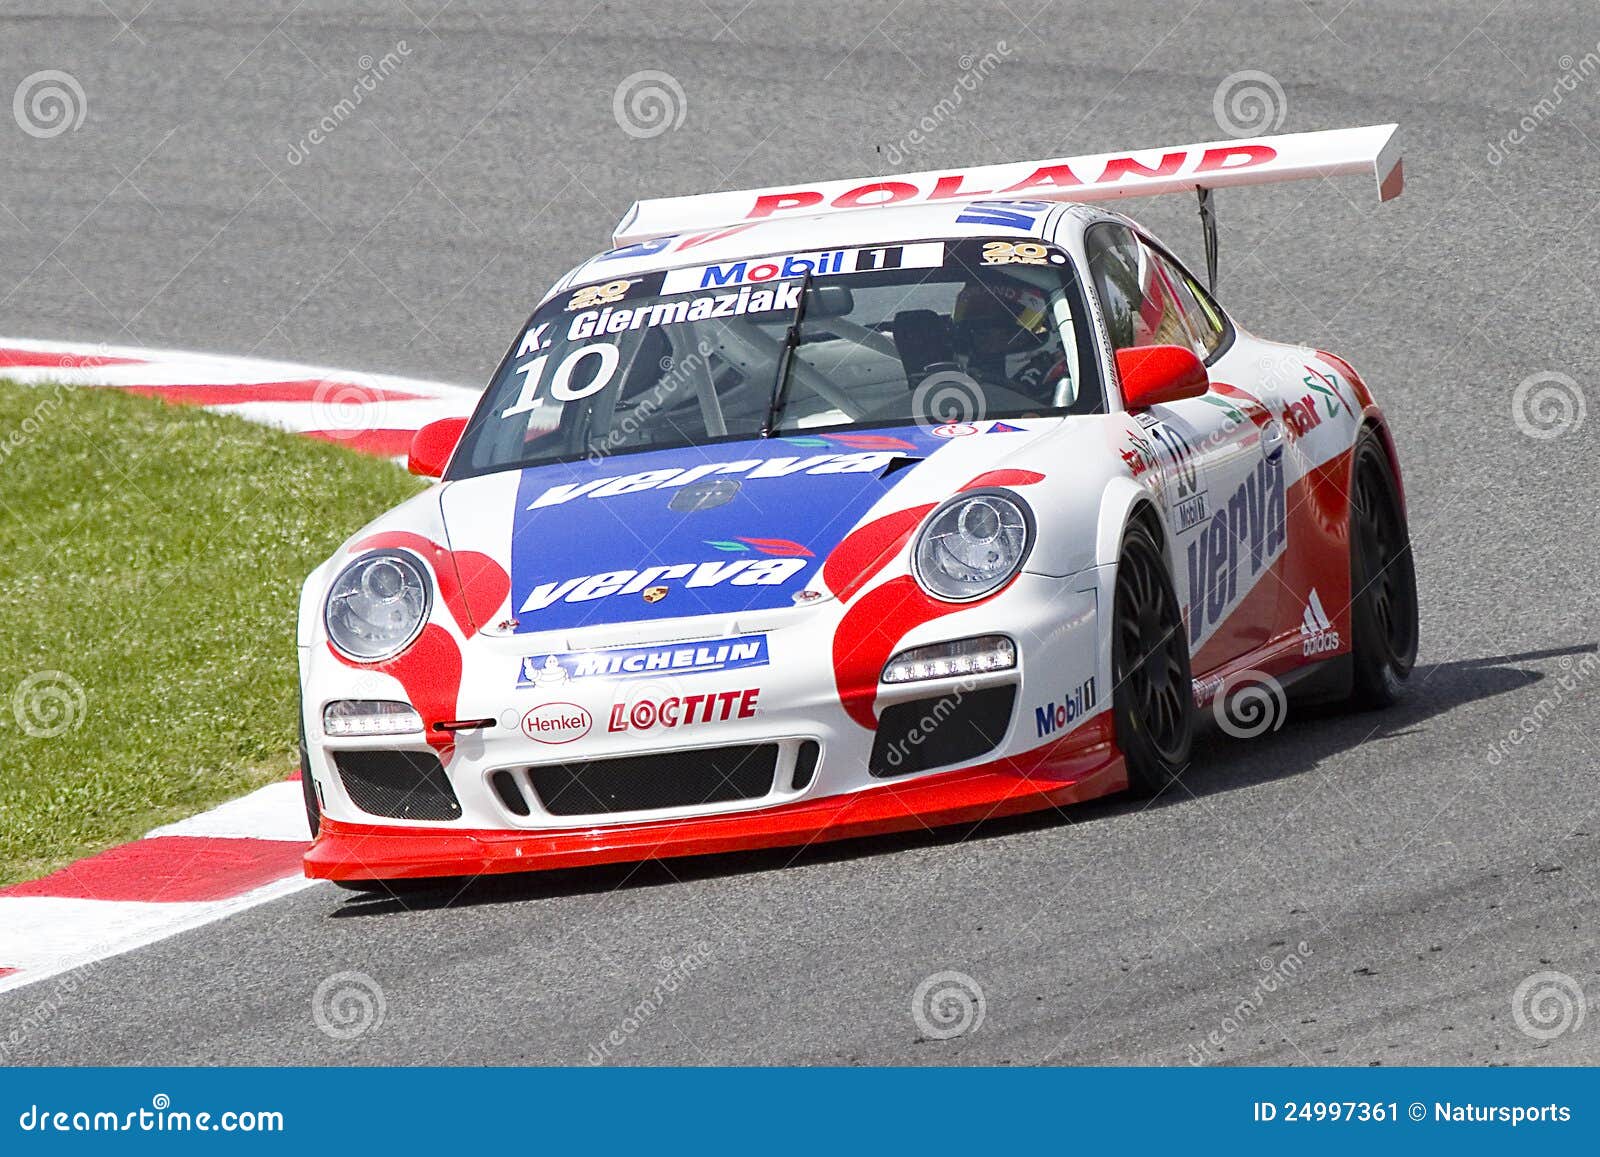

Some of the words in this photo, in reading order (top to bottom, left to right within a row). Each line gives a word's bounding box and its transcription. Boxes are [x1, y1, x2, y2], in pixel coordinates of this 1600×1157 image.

[745, 145, 1278, 219] POLAND
[700, 251, 844, 288] Mobil
[982, 241, 1048, 259] 20
[571, 280, 632, 301] 20
[515, 322, 552, 359] K.
[566, 281, 805, 341] Giermaziak
[501, 342, 620, 420] 10
[525, 451, 909, 511] verva
[1152, 423, 1197, 498] 10
[1187, 450, 1286, 647] verva
[519, 558, 808, 613] verva
[574, 641, 761, 677] MICHELIN
[1303, 629, 1340, 657] adidas
[526, 713, 587, 732] Henkel
[608, 688, 761, 733] LOCTITE
[1035, 686, 1083, 738] Mobil
